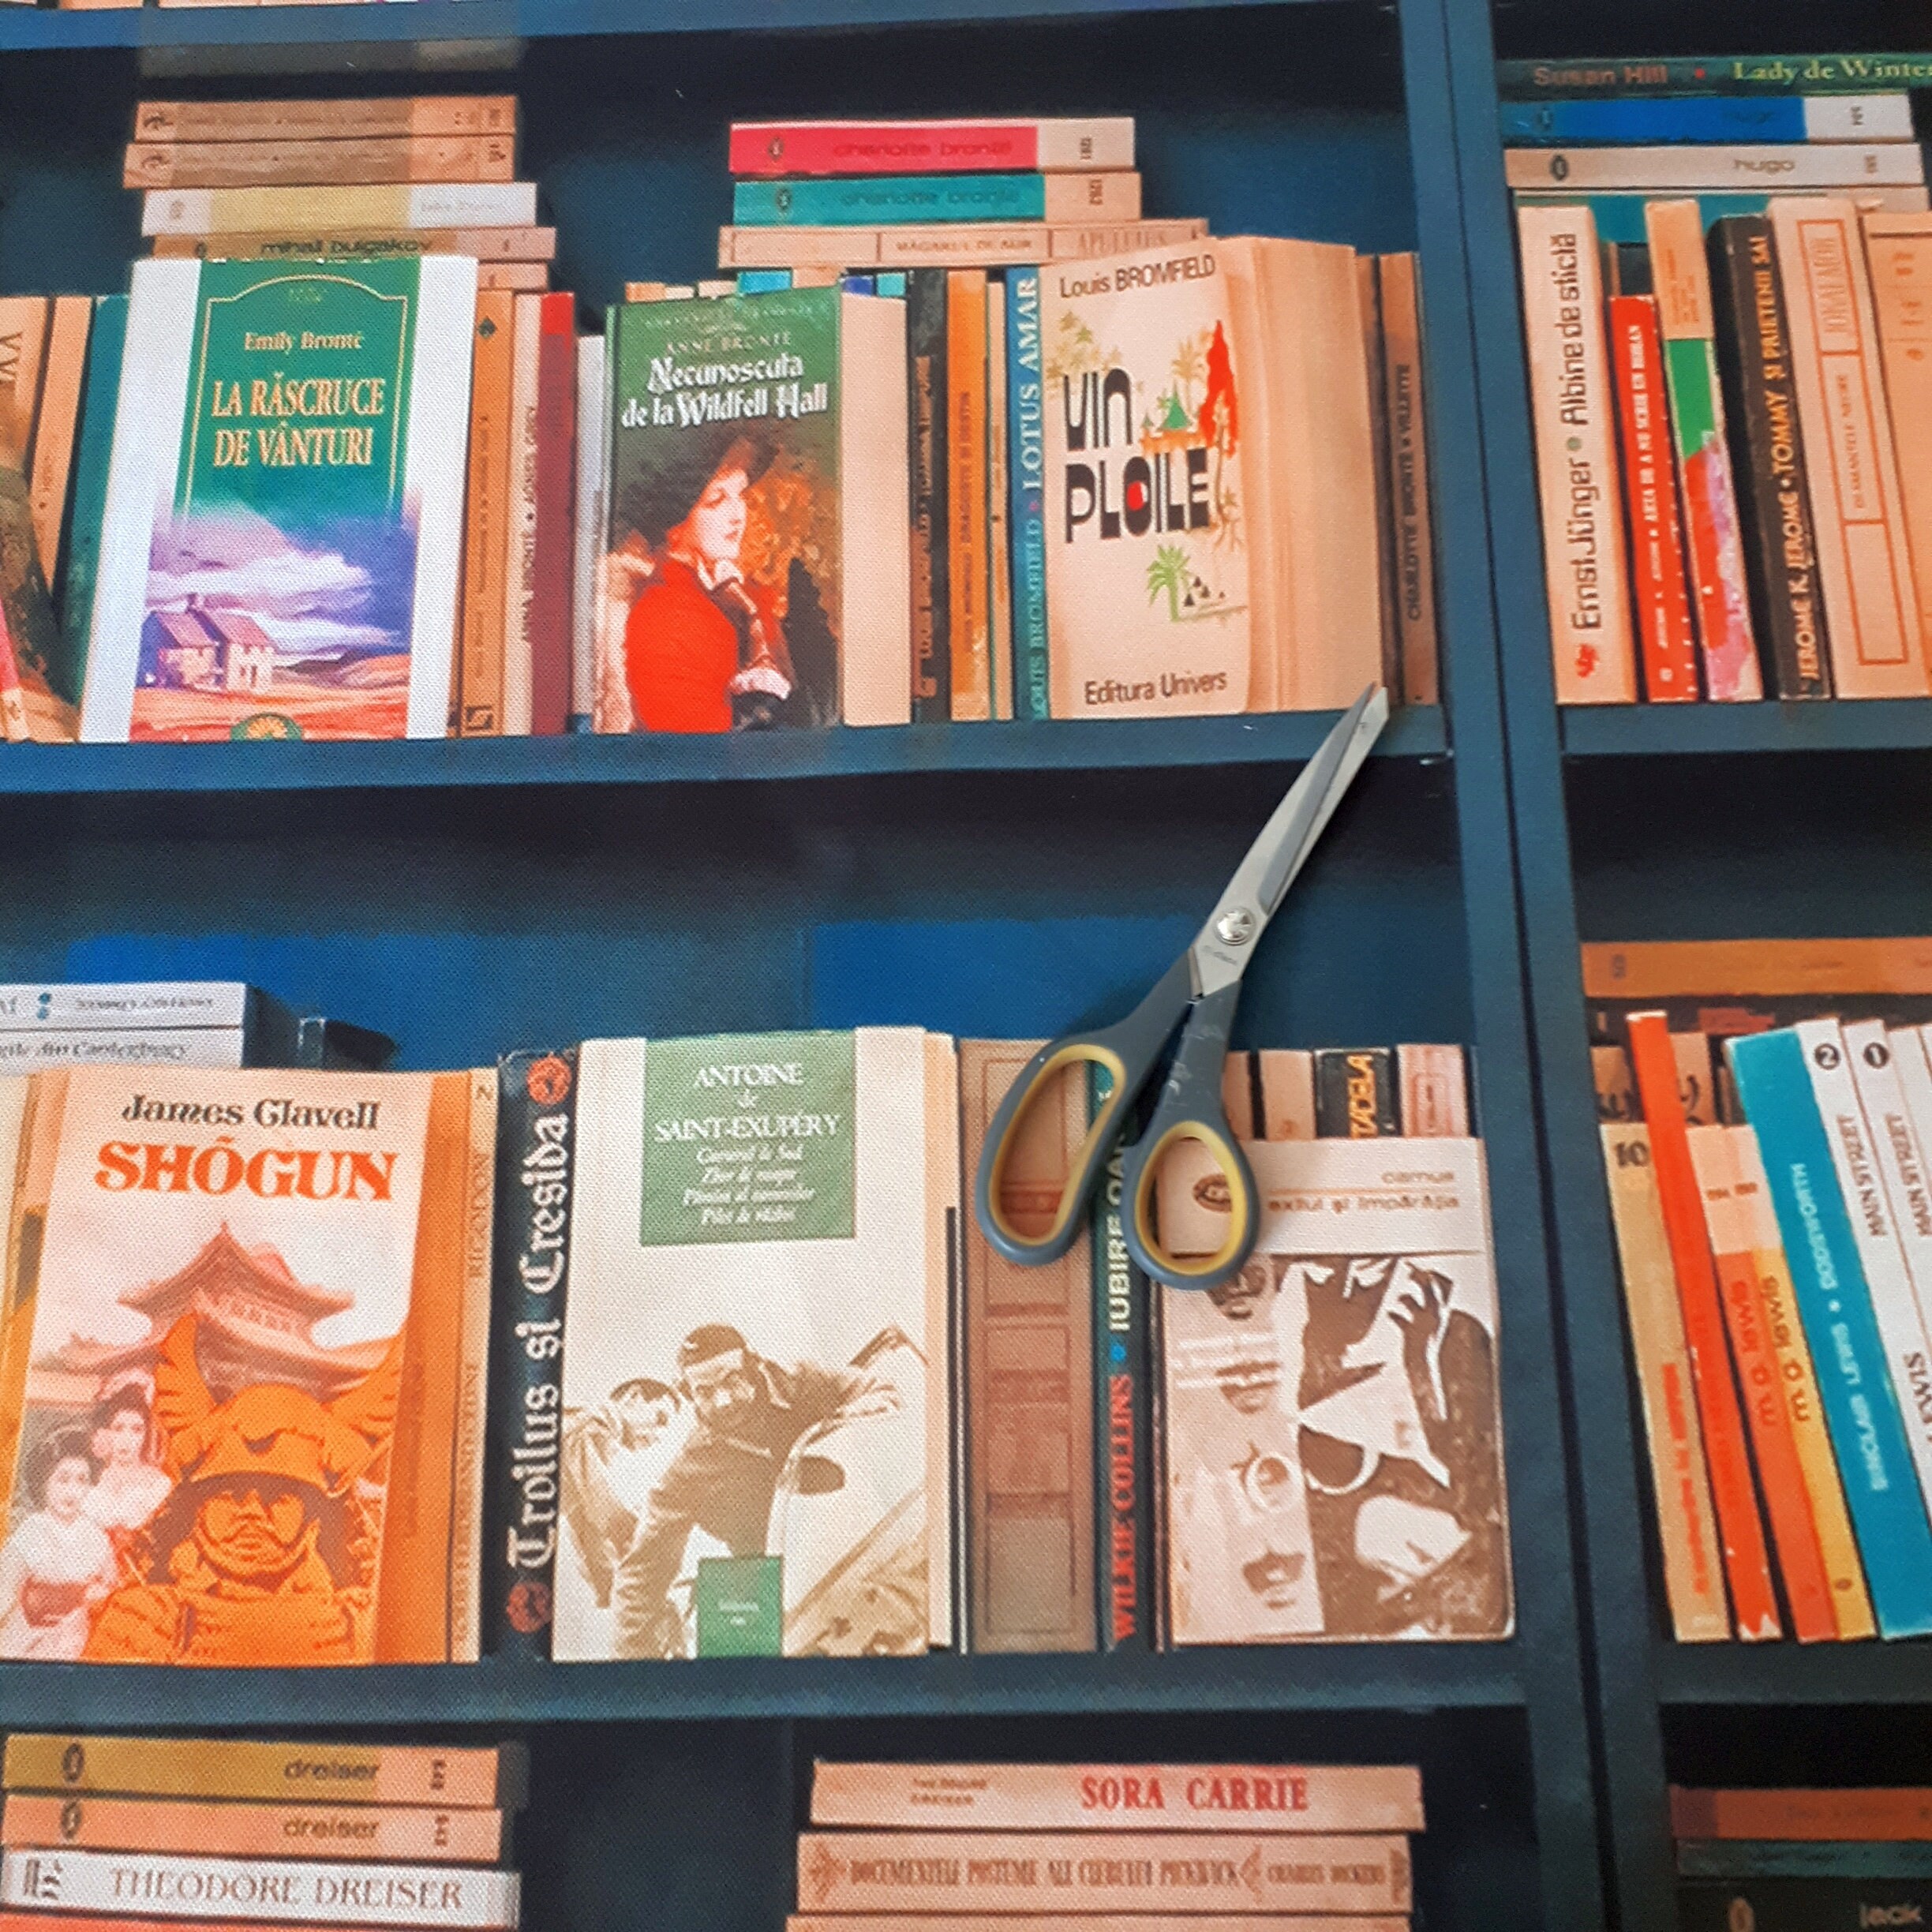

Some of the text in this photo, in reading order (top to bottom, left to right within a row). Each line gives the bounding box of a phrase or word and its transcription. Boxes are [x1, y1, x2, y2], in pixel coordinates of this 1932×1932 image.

[1735, 62, 1795, 84] Lady
[1805, 62, 1835, 80] de
[1734, 157, 1796, 175] hugo
[1060, 254, 1216, 298] Louis BROMFIELD
[1016, 277, 1041, 373] AMAR
[1556, 305, 1585, 339] de
[1750, 271, 1782, 359] PRIETENII
[212, 371, 386, 417] LA RĂSCRUCE
[621, 398, 648, 429] de
[653, 396, 675, 426] la
[775, 382, 828, 420] Hall
[646, 352, 804, 396] Necunoscuta
[1559, 343, 1589, 426] Albine
[214, 421, 373, 467] DE VÂNTURI
[1019, 384, 1043, 491] LOTUS
[1764, 391, 1795, 474] TOMMY
[1065, 446, 1212, 545] PLOILE
[1566, 456, 1599, 556] Jünger
[1778, 490, 1809, 570] JEROME
[1571, 558, 1601, 631] Ernst
[1791, 601, 1820, 681] JEROME
[1084, 669, 1229, 706] Editura Univers
[121, 1094, 245, 1126] James
[694, 1063, 803, 1088] ANTOINE
[1348, 1053, 1379, 1138] TADELA
[1614, 1140, 1651, 1167] 10
[1836, 1114, 1889, 1237] MAIN STREET
[1884, 1114, 1922, 1189] STREET
[517, 1112, 570, 1294] Cresida
[1759, 1275, 1792, 1349] lewis
[1829, 1322, 1862, 1384] LEWIS
[506, 1382, 561, 1570] Troilus
[1109, 1374, 1136, 1511] COLLINS
[1849, 1393, 1889, 1491] SINCLAIR
[1111, 1513, 1138, 1642] WILKIE
[283, 1757, 380, 1780] dreiser
[1081, 1776, 1309, 1811] SORA CARRIE
[283, 1815, 380, 1839] dreiser
[110, 1866, 462, 1910] THEODORE DREISER
